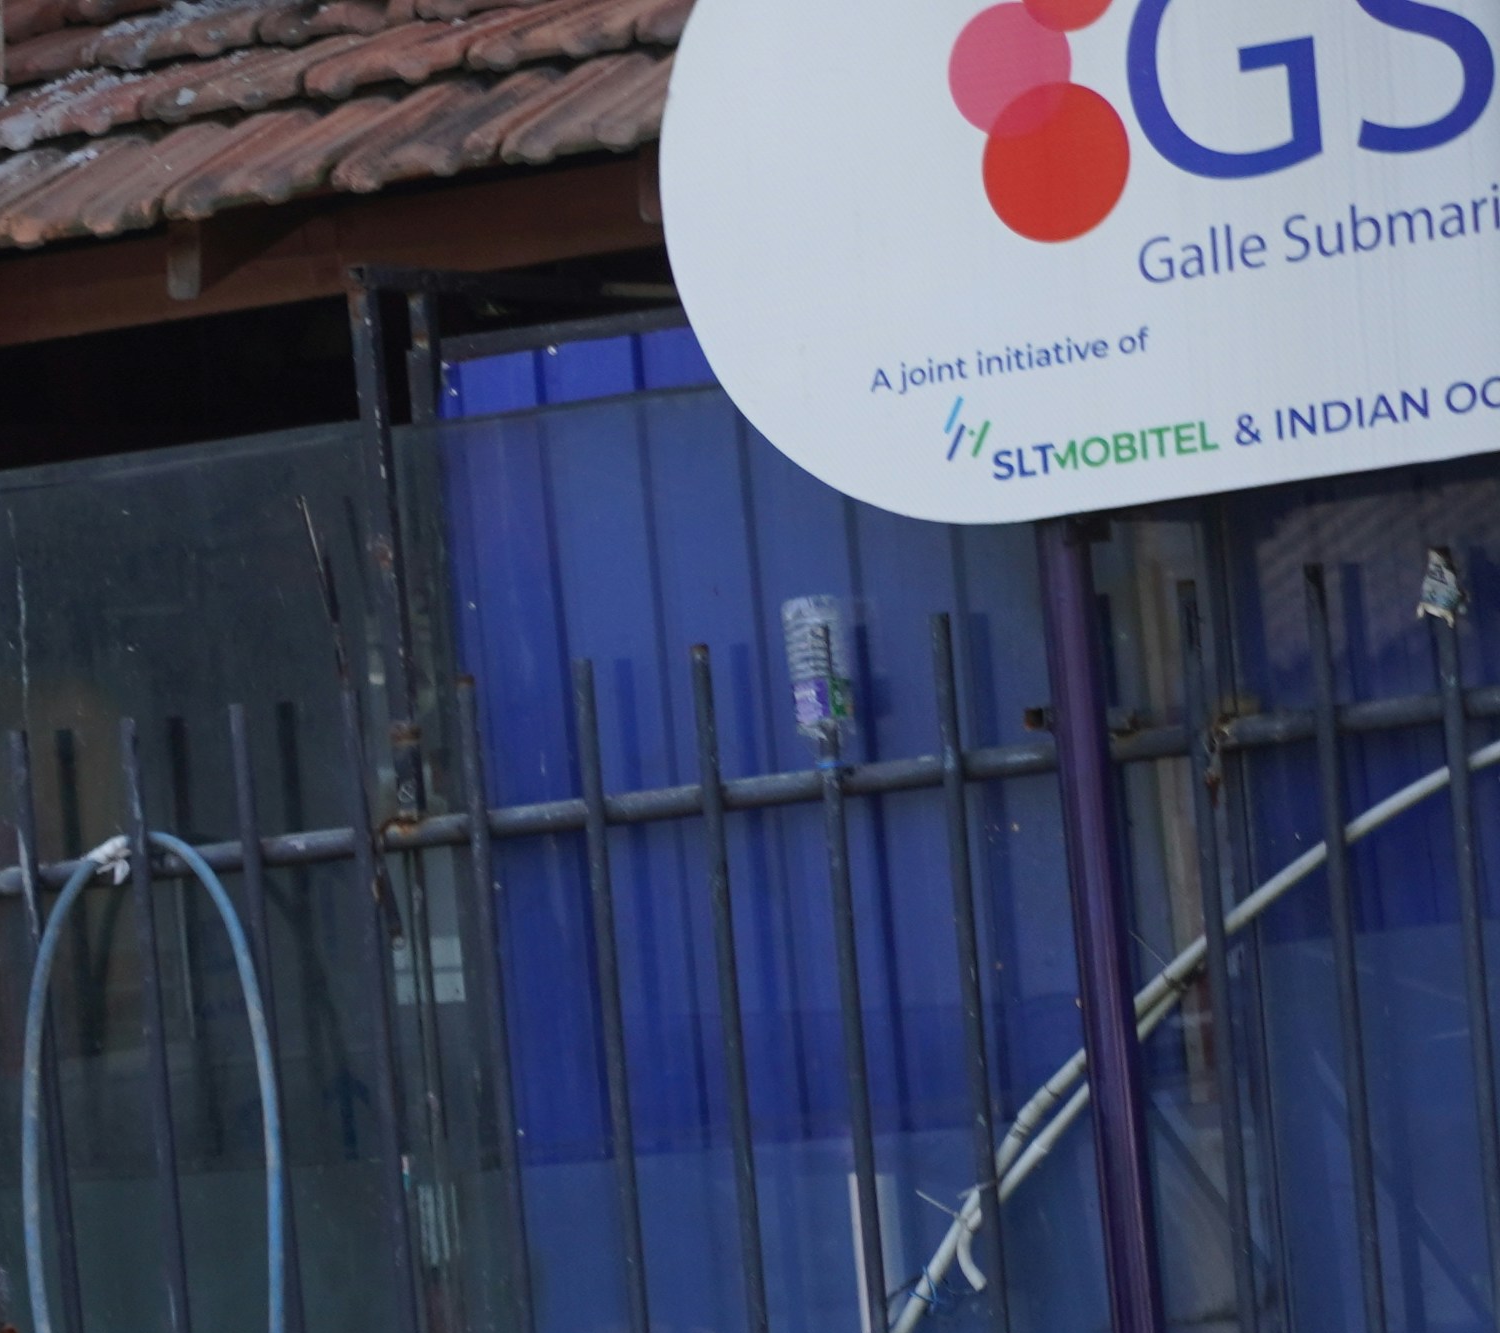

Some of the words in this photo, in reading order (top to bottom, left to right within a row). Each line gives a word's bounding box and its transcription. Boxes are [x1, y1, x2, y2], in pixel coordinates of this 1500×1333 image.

[1139, 224, 1268, 284] Galle
[871, 368, 892, 393] A
[899, 358, 967, 395] joint
[978, 338, 1110, 377] initiative
[1119, 326, 1149, 355] of
[1235, 414, 1263, 447] &
[1275, 388, 1430, 441] INDIAN
